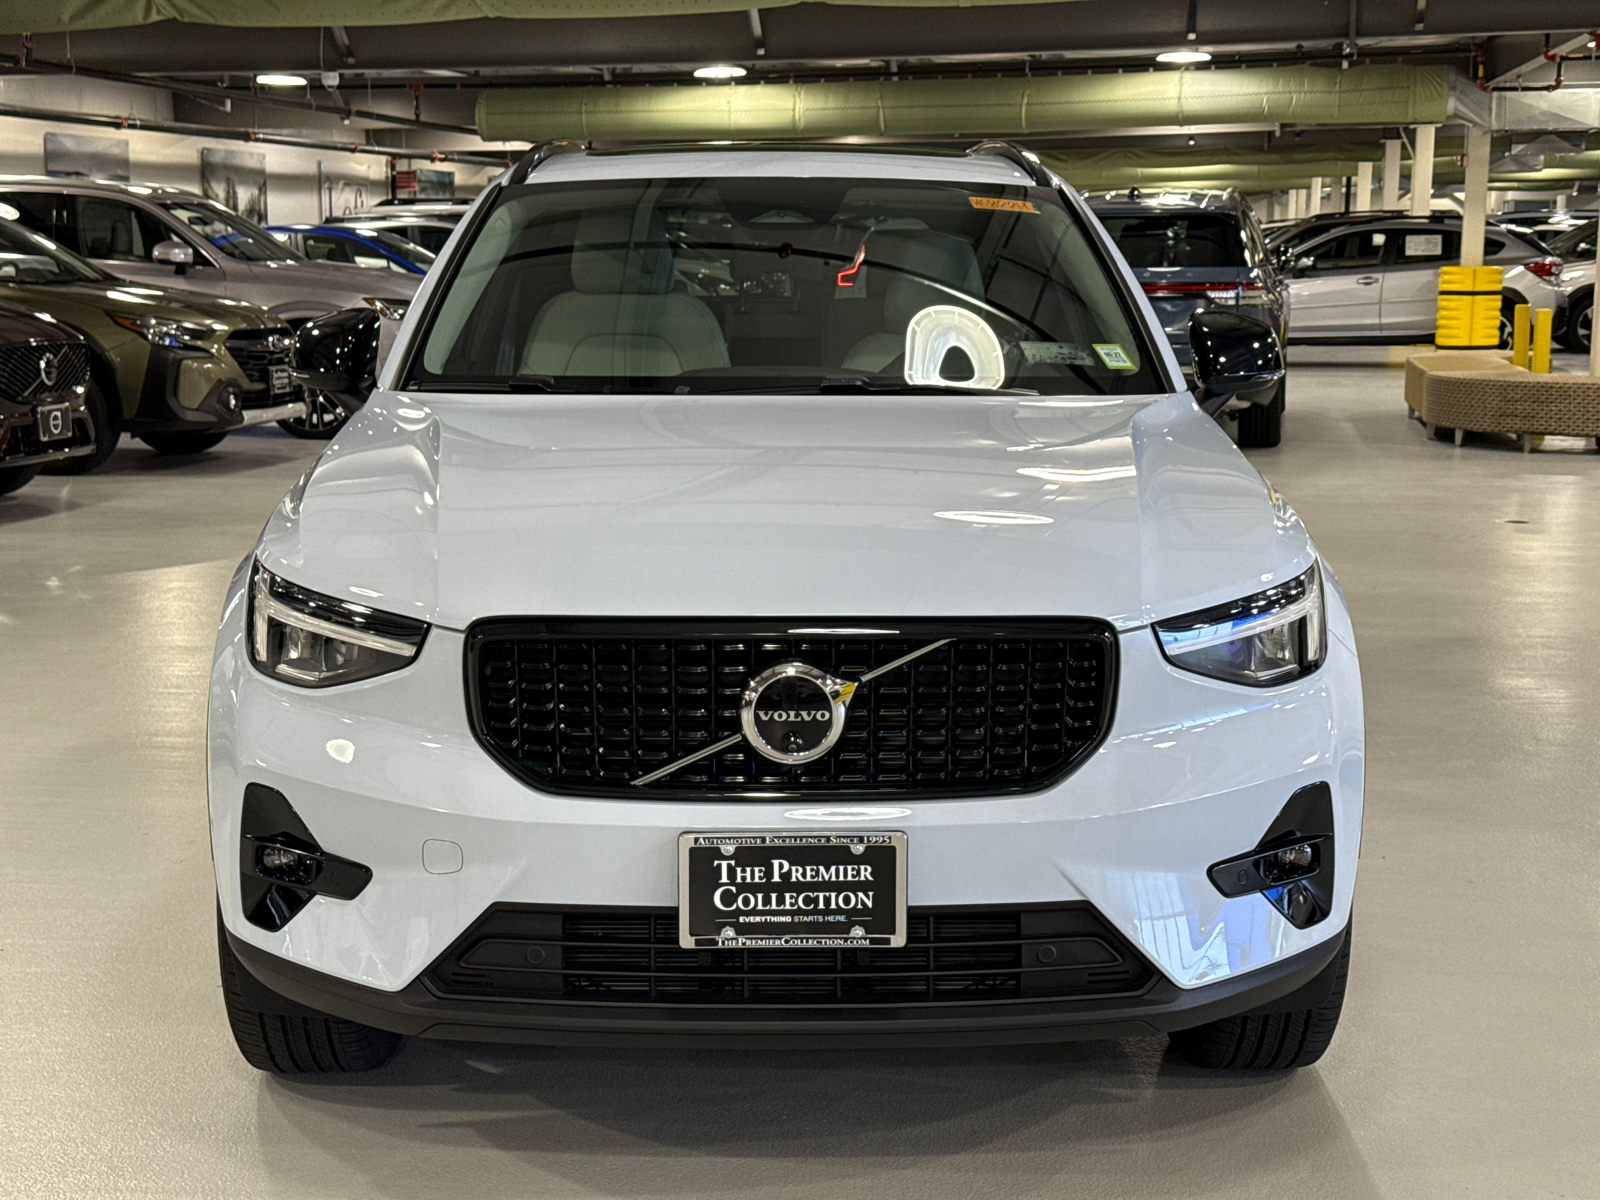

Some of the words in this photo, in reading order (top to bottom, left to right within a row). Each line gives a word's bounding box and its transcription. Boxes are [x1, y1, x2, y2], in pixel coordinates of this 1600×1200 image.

[756, 710, 830, 721] VOLVO
[697, 837, 763, 846] AUTOMOTIVE
[765, 836, 827, 845] EXCELLENCE
[829, 835, 860, 845] SINCE
[862, 835, 890, 845] 1995
[713, 860, 766, 884] THE
[771, 859, 874, 882] PREMIER
[713, 886, 875, 911] COLLECTION
[793, 915, 824, 923] STARTS
